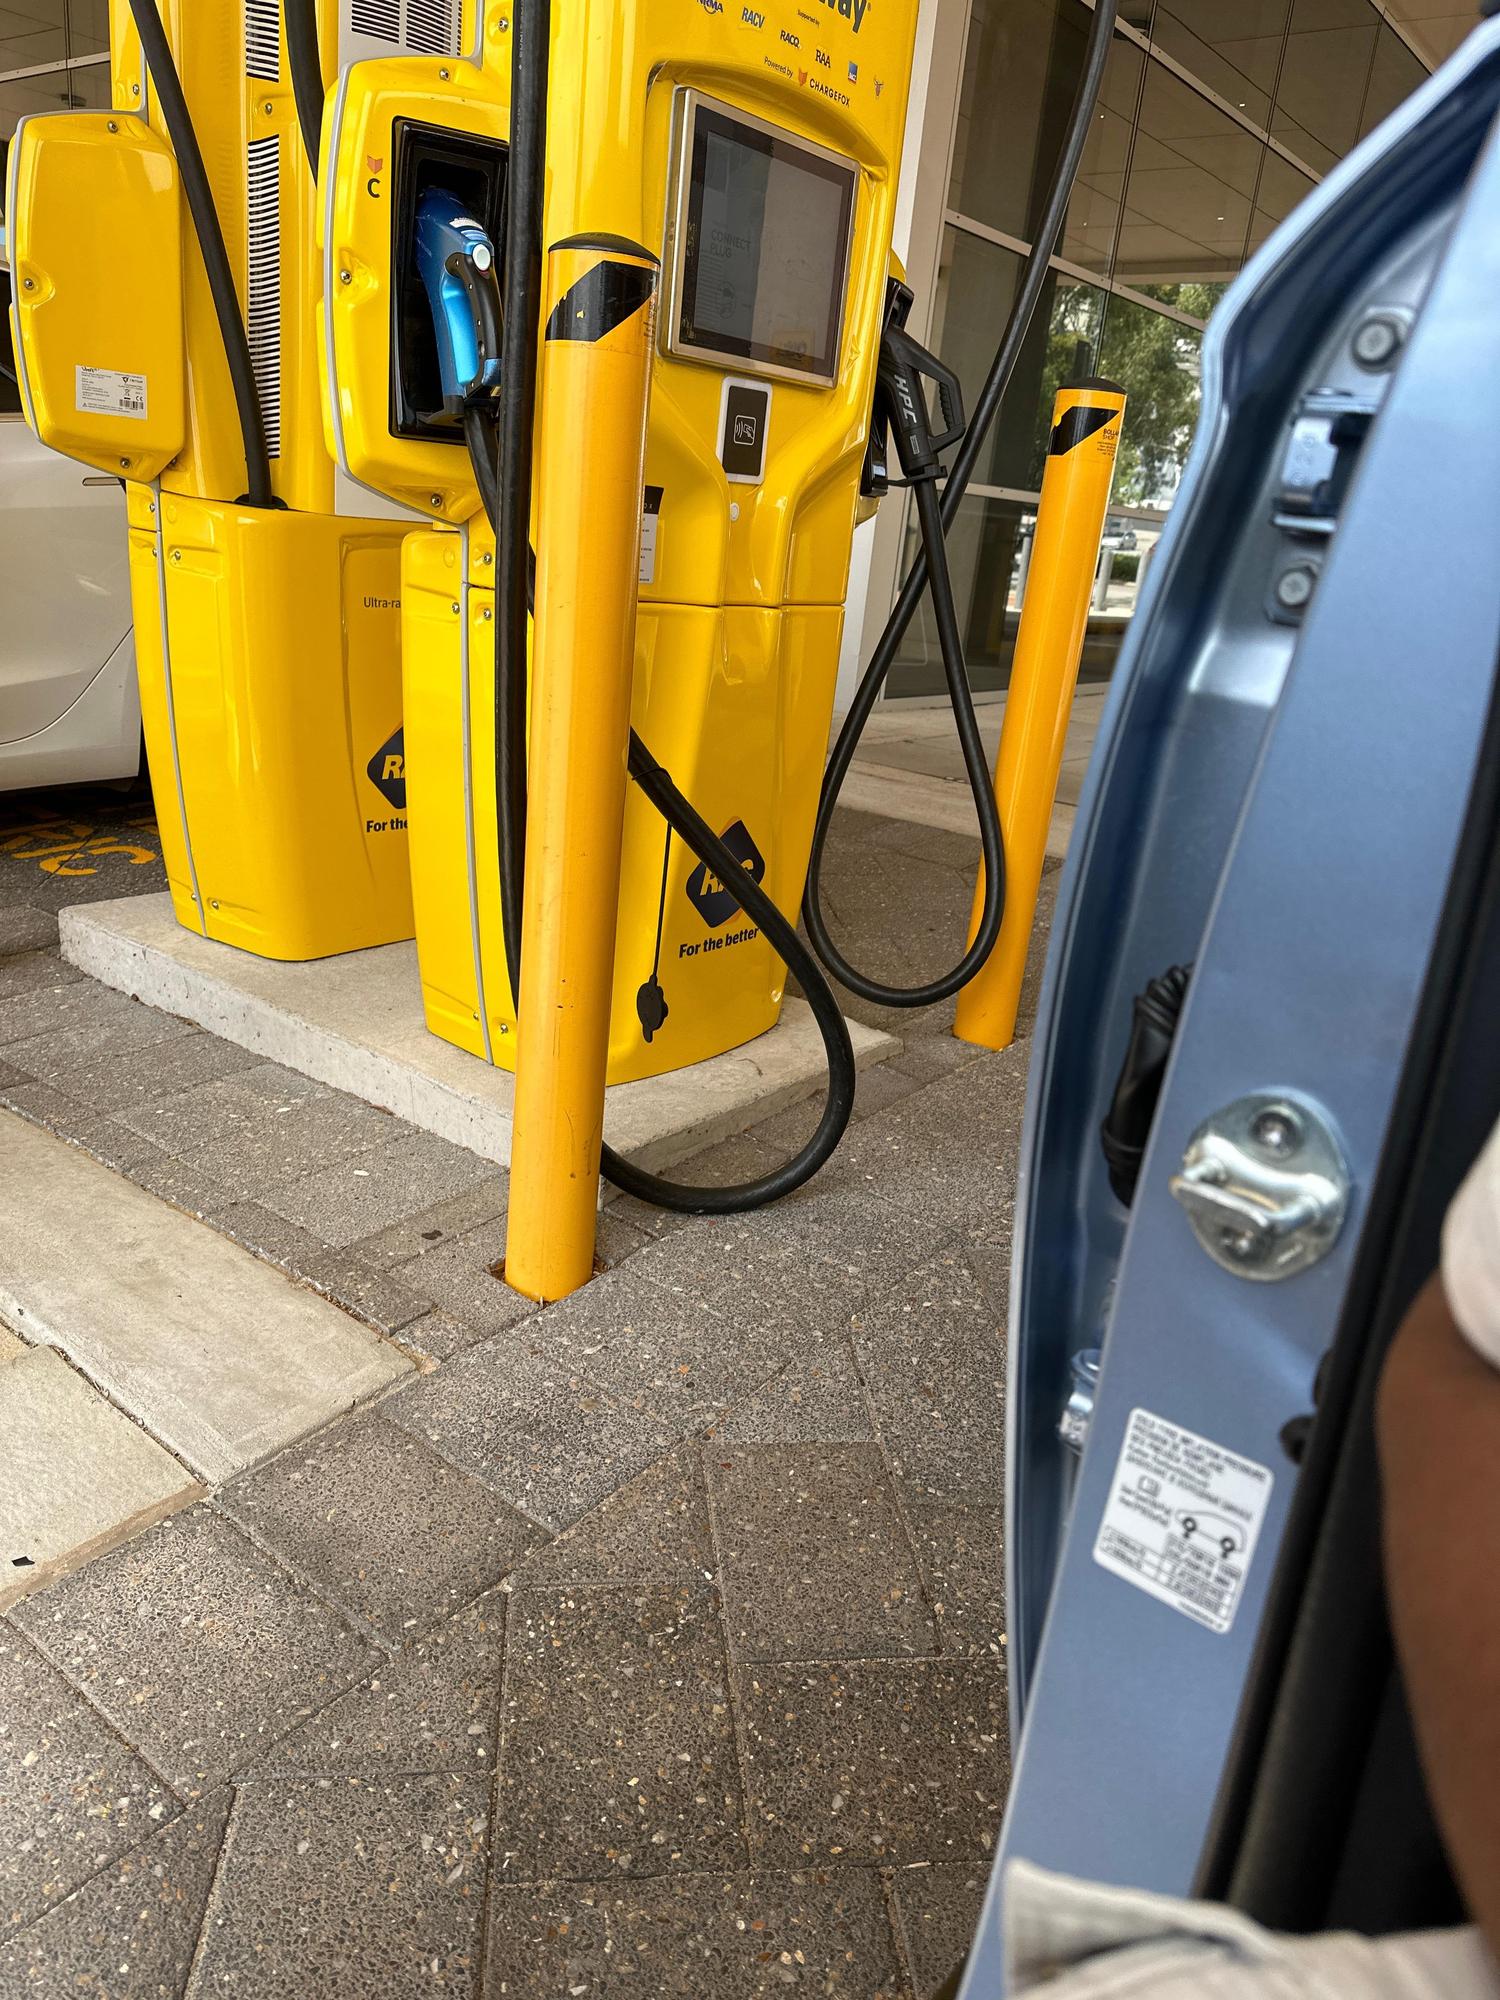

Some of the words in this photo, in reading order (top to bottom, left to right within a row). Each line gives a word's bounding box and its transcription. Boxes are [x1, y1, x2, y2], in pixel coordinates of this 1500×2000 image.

[741, 7, 765, 28] RACV
[816, 49, 831, 68] RAA
[764, 56, 786, 73] Powered
[787, 67, 793, 78] by
[810, 78, 850, 107] CHARGEFOX
[367, 178, 380, 198] C
[711, 229, 751, 252] CONNECT
[366, 821, 387, 832] For
[679, 944, 701, 958] For
[703, 938, 723, 952] the
[725, 928, 760, 946] better
